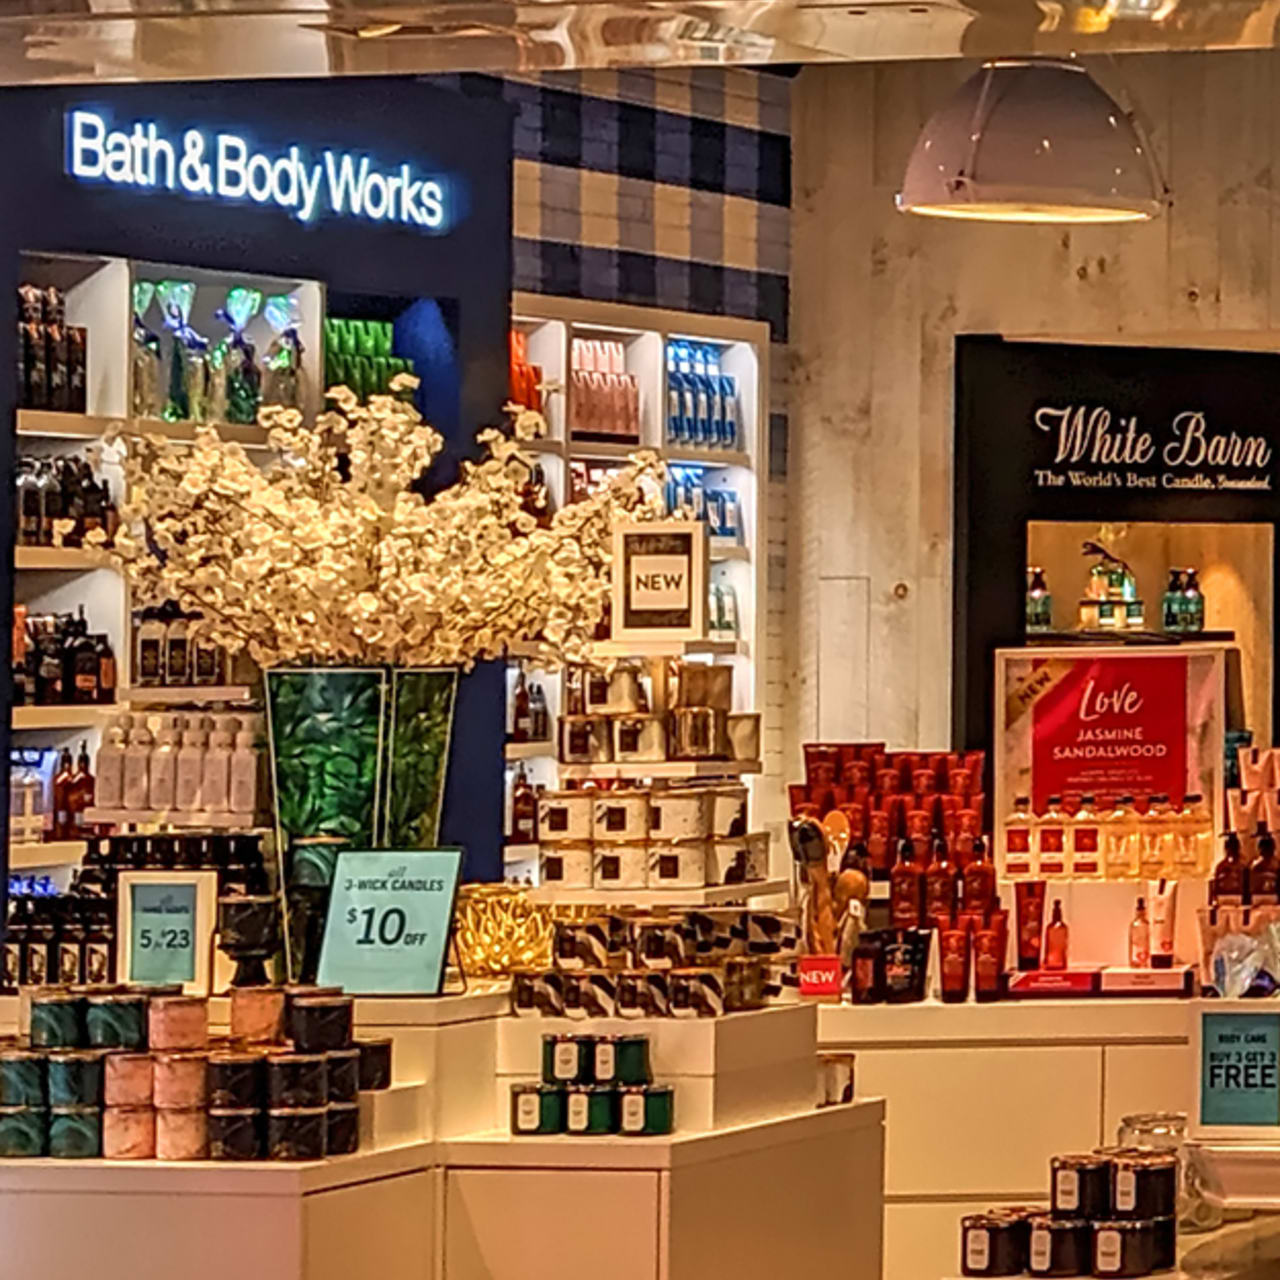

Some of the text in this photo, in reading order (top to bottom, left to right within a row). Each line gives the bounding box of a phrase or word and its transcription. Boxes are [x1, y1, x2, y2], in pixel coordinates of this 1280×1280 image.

[72, 110, 443, 227] Bath & Body Works
[1034, 405, 1272, 468] White Barn
[1034, 471, 1065, 487] The
[1068, 471, 1122, 487] World's
[1126, 472, 1156, 488] Best
[635, 573, 683, 591] NEW
[1078, 679, 1145, 721] Love
[1077, 726, 1144, 742] JASMINE
[1053, 743, 1167, 760] SANDALWOOD
[391, 879, 444, 892] CANDLES
[346, 906, 428, 946] $10 OFF
[800, 968, 835, 985] NEW
[1208, 1064, 1277, 1089] FREE
